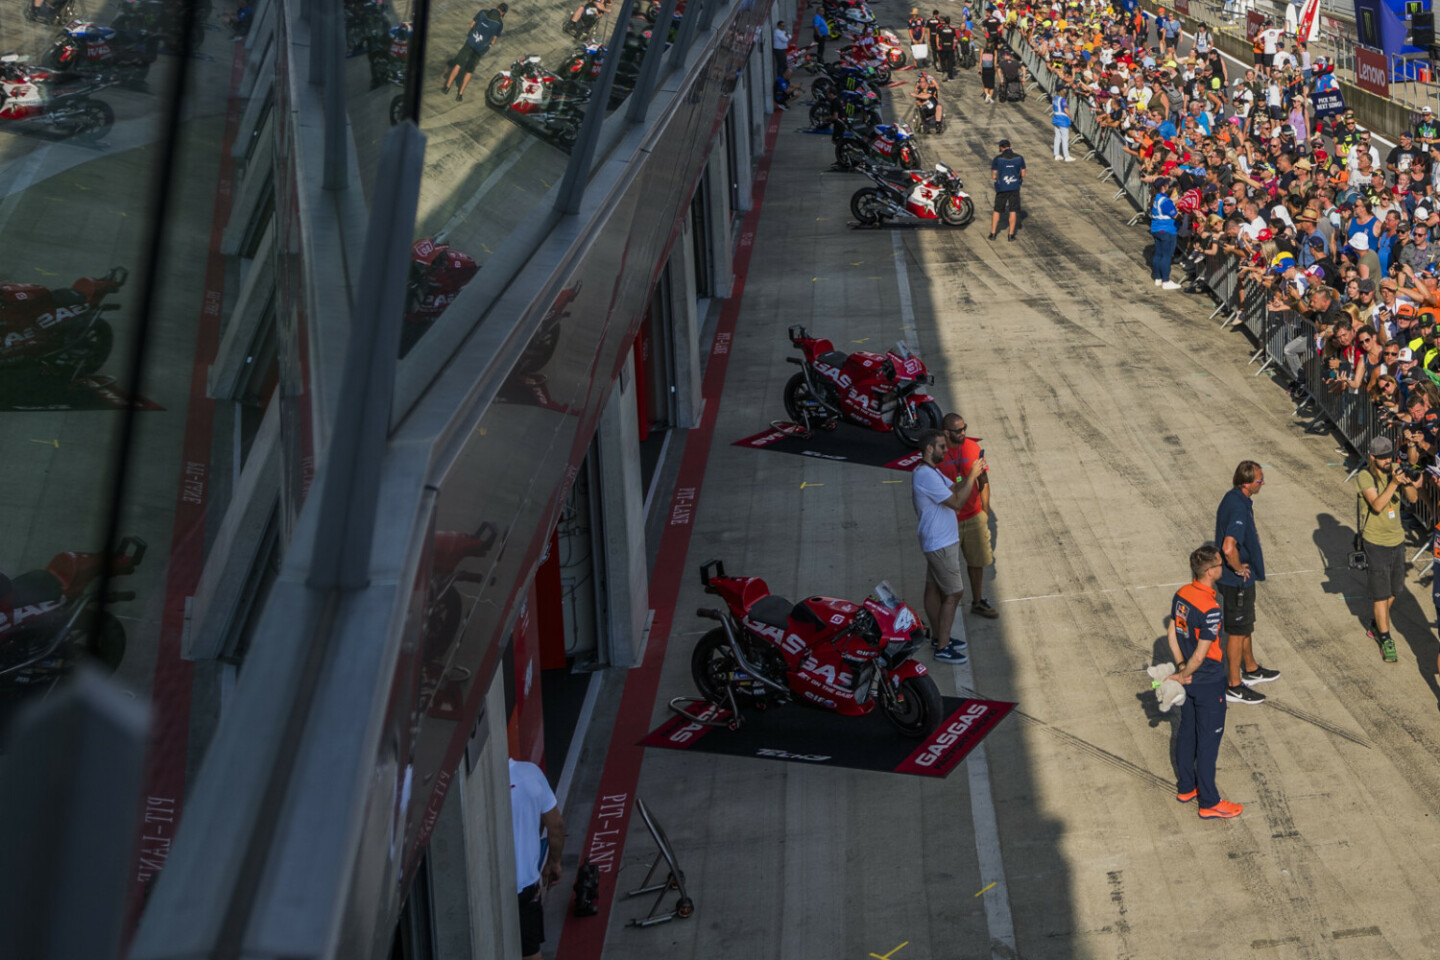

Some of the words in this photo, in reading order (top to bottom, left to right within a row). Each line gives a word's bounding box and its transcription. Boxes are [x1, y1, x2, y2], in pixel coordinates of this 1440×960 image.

[1357, 57, 1386, 87] Lenovo
[671, 486, 696, 526] PIT-LANE
[742, 615, 807, 656] GAS
[915, 704, 988, 767] GASGAS
[588, 793, 628, 873] PIT-LANE
